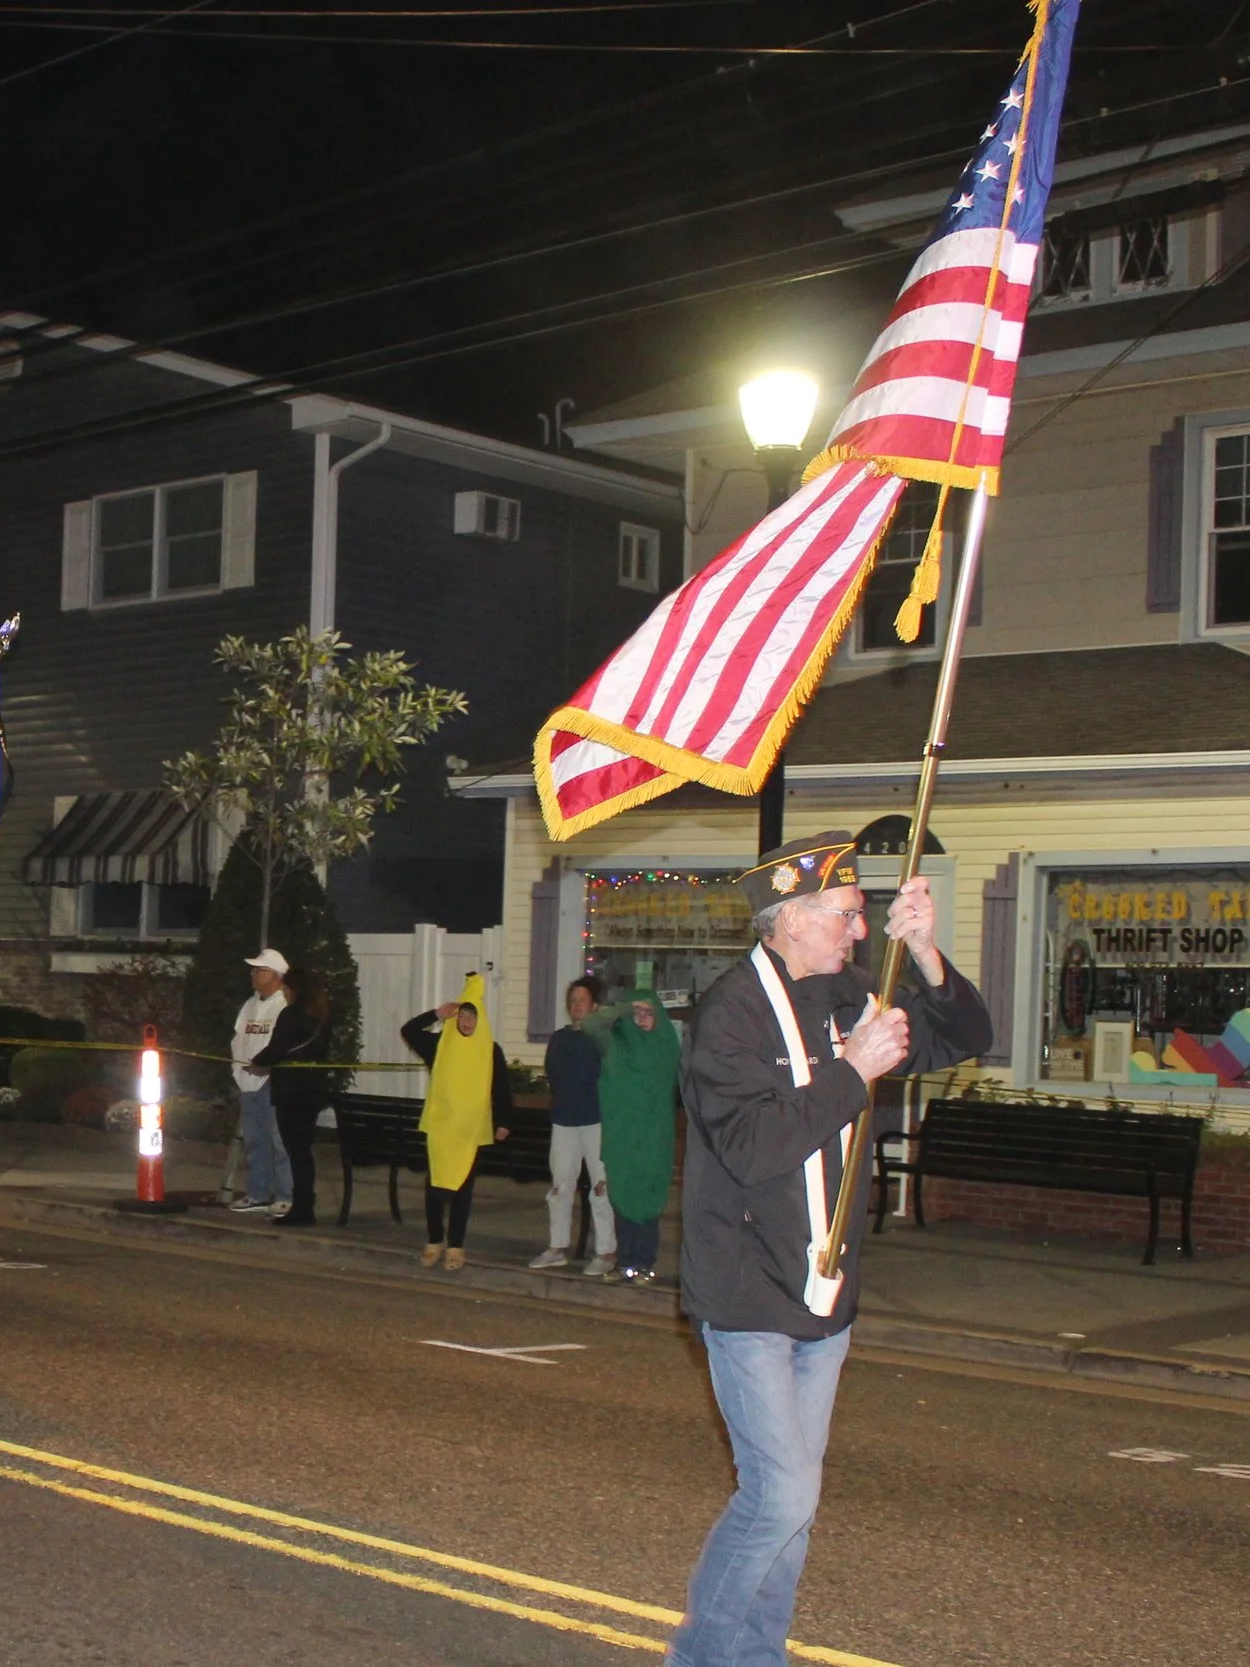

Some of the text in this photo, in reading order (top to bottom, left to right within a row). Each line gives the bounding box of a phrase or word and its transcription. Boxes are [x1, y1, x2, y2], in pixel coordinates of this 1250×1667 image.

[1069, 891, 1250, 920] CROOKED TA
[1093, 928, 1244, 953] THRIFT SHOP
